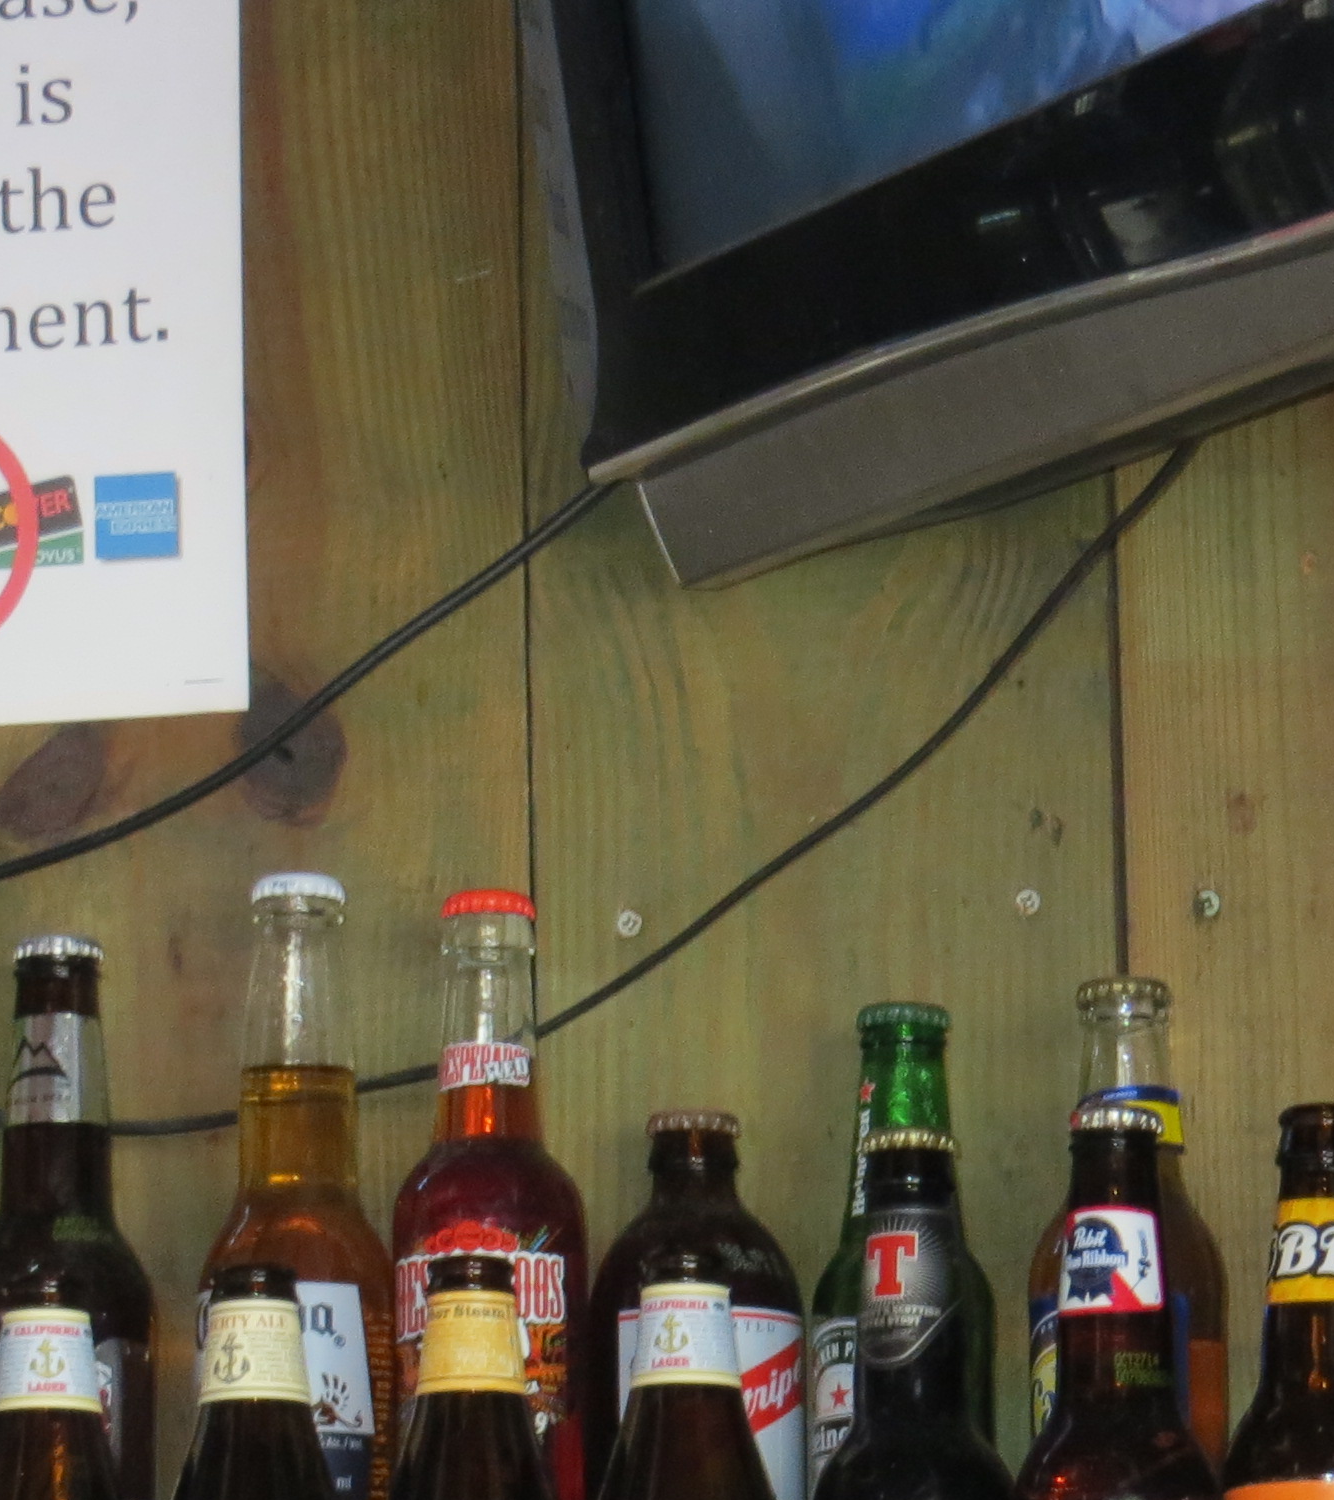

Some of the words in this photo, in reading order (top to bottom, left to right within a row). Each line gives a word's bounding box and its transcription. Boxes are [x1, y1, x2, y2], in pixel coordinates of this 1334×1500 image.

[15, 63, 74, 126] is
[37, 548, 75, 563] VUS
[850, 1108, 871, 1217] Heinen
[1072, 1227, 1108, 1250] Pabst
[1082, 1248, 1127, 1268] Ribbon
[867, 1231, 919, 1299] T
[396, 1251, 567, 1344] DESDOS
[209, 1313, 252, 1331] ERTY
[256, 1313, 287, 1329] ALE
